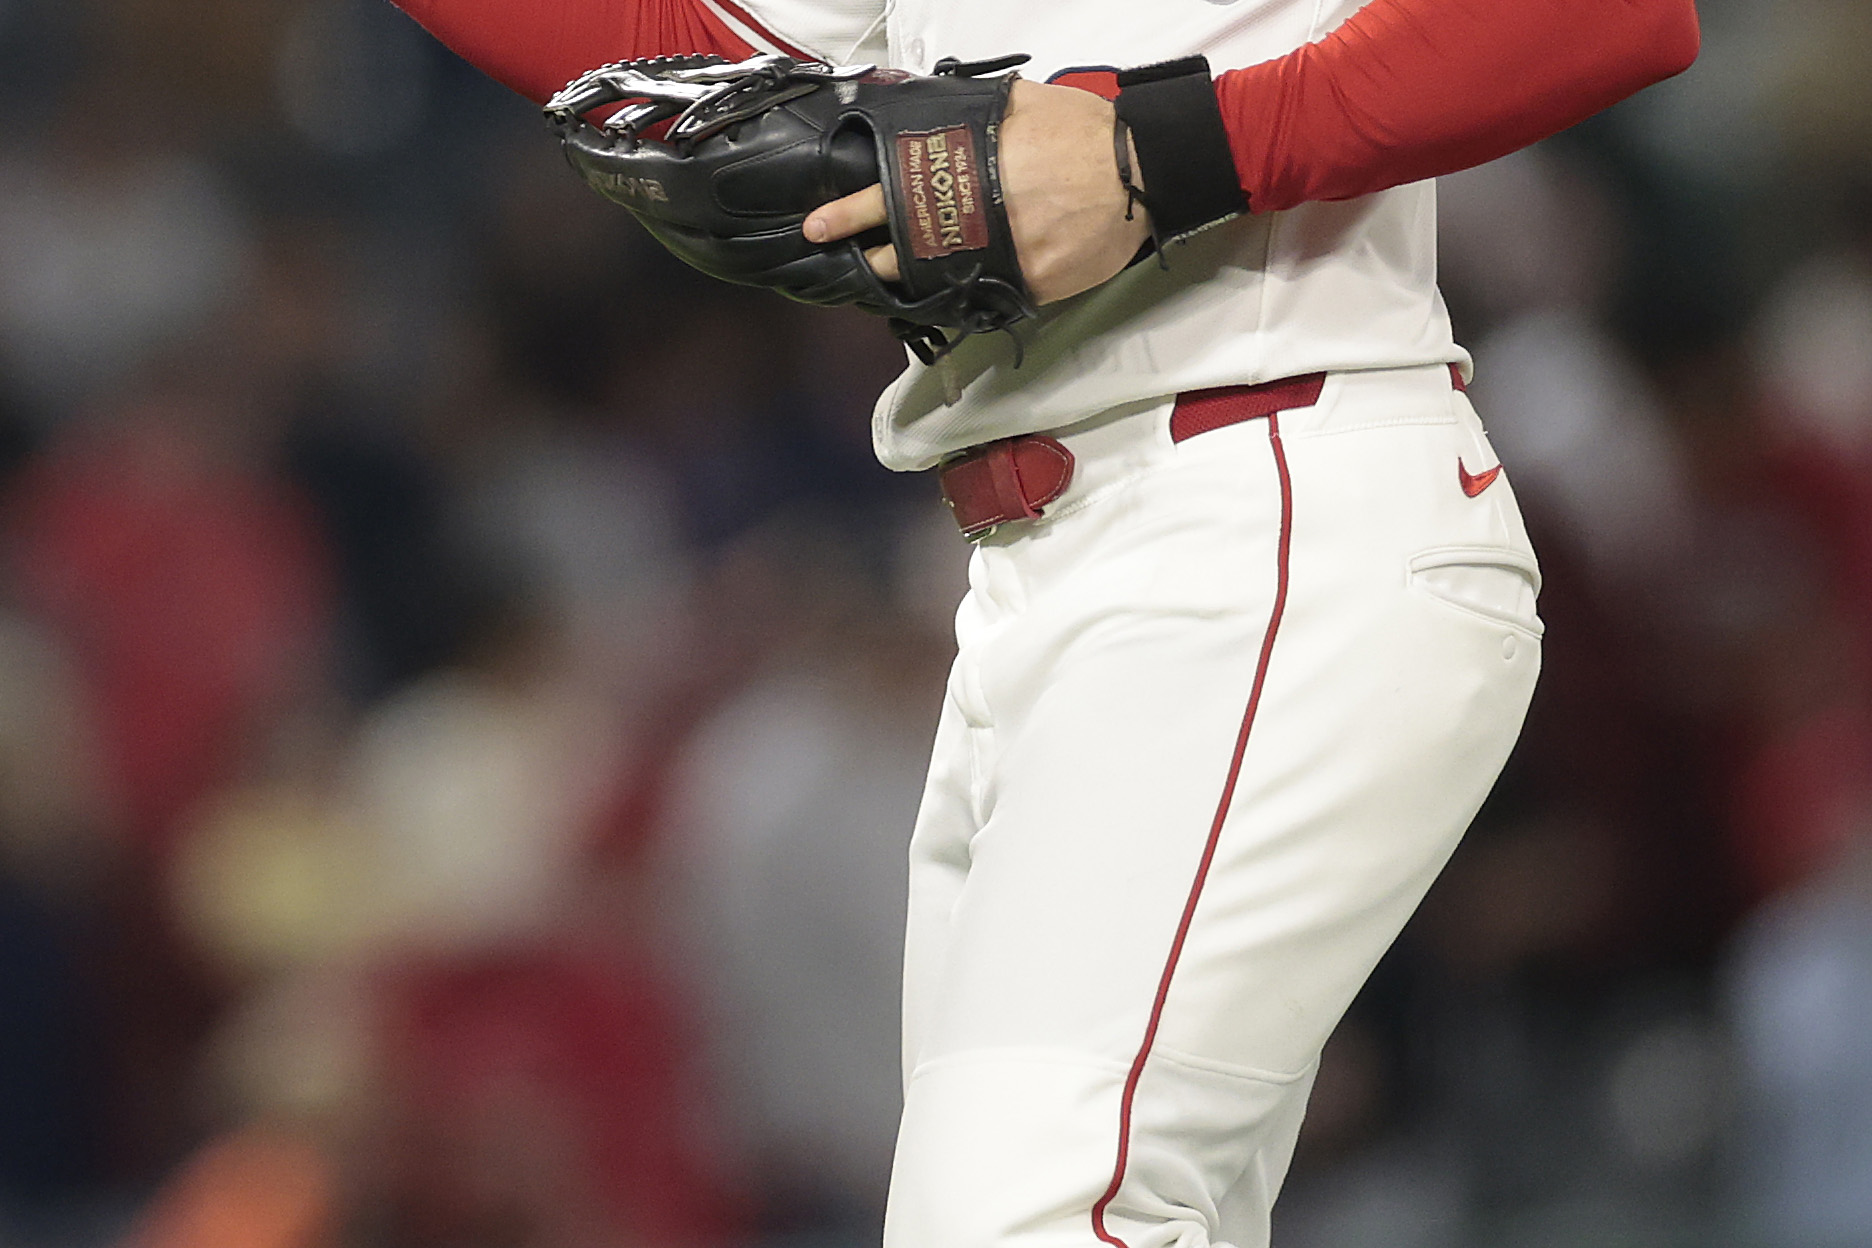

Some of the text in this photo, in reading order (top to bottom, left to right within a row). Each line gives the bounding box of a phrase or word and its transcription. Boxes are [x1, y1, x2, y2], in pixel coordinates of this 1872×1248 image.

[908, 140, 937, 247] AMERICAN MADE
[957, 174, 975, 214] SINCE
